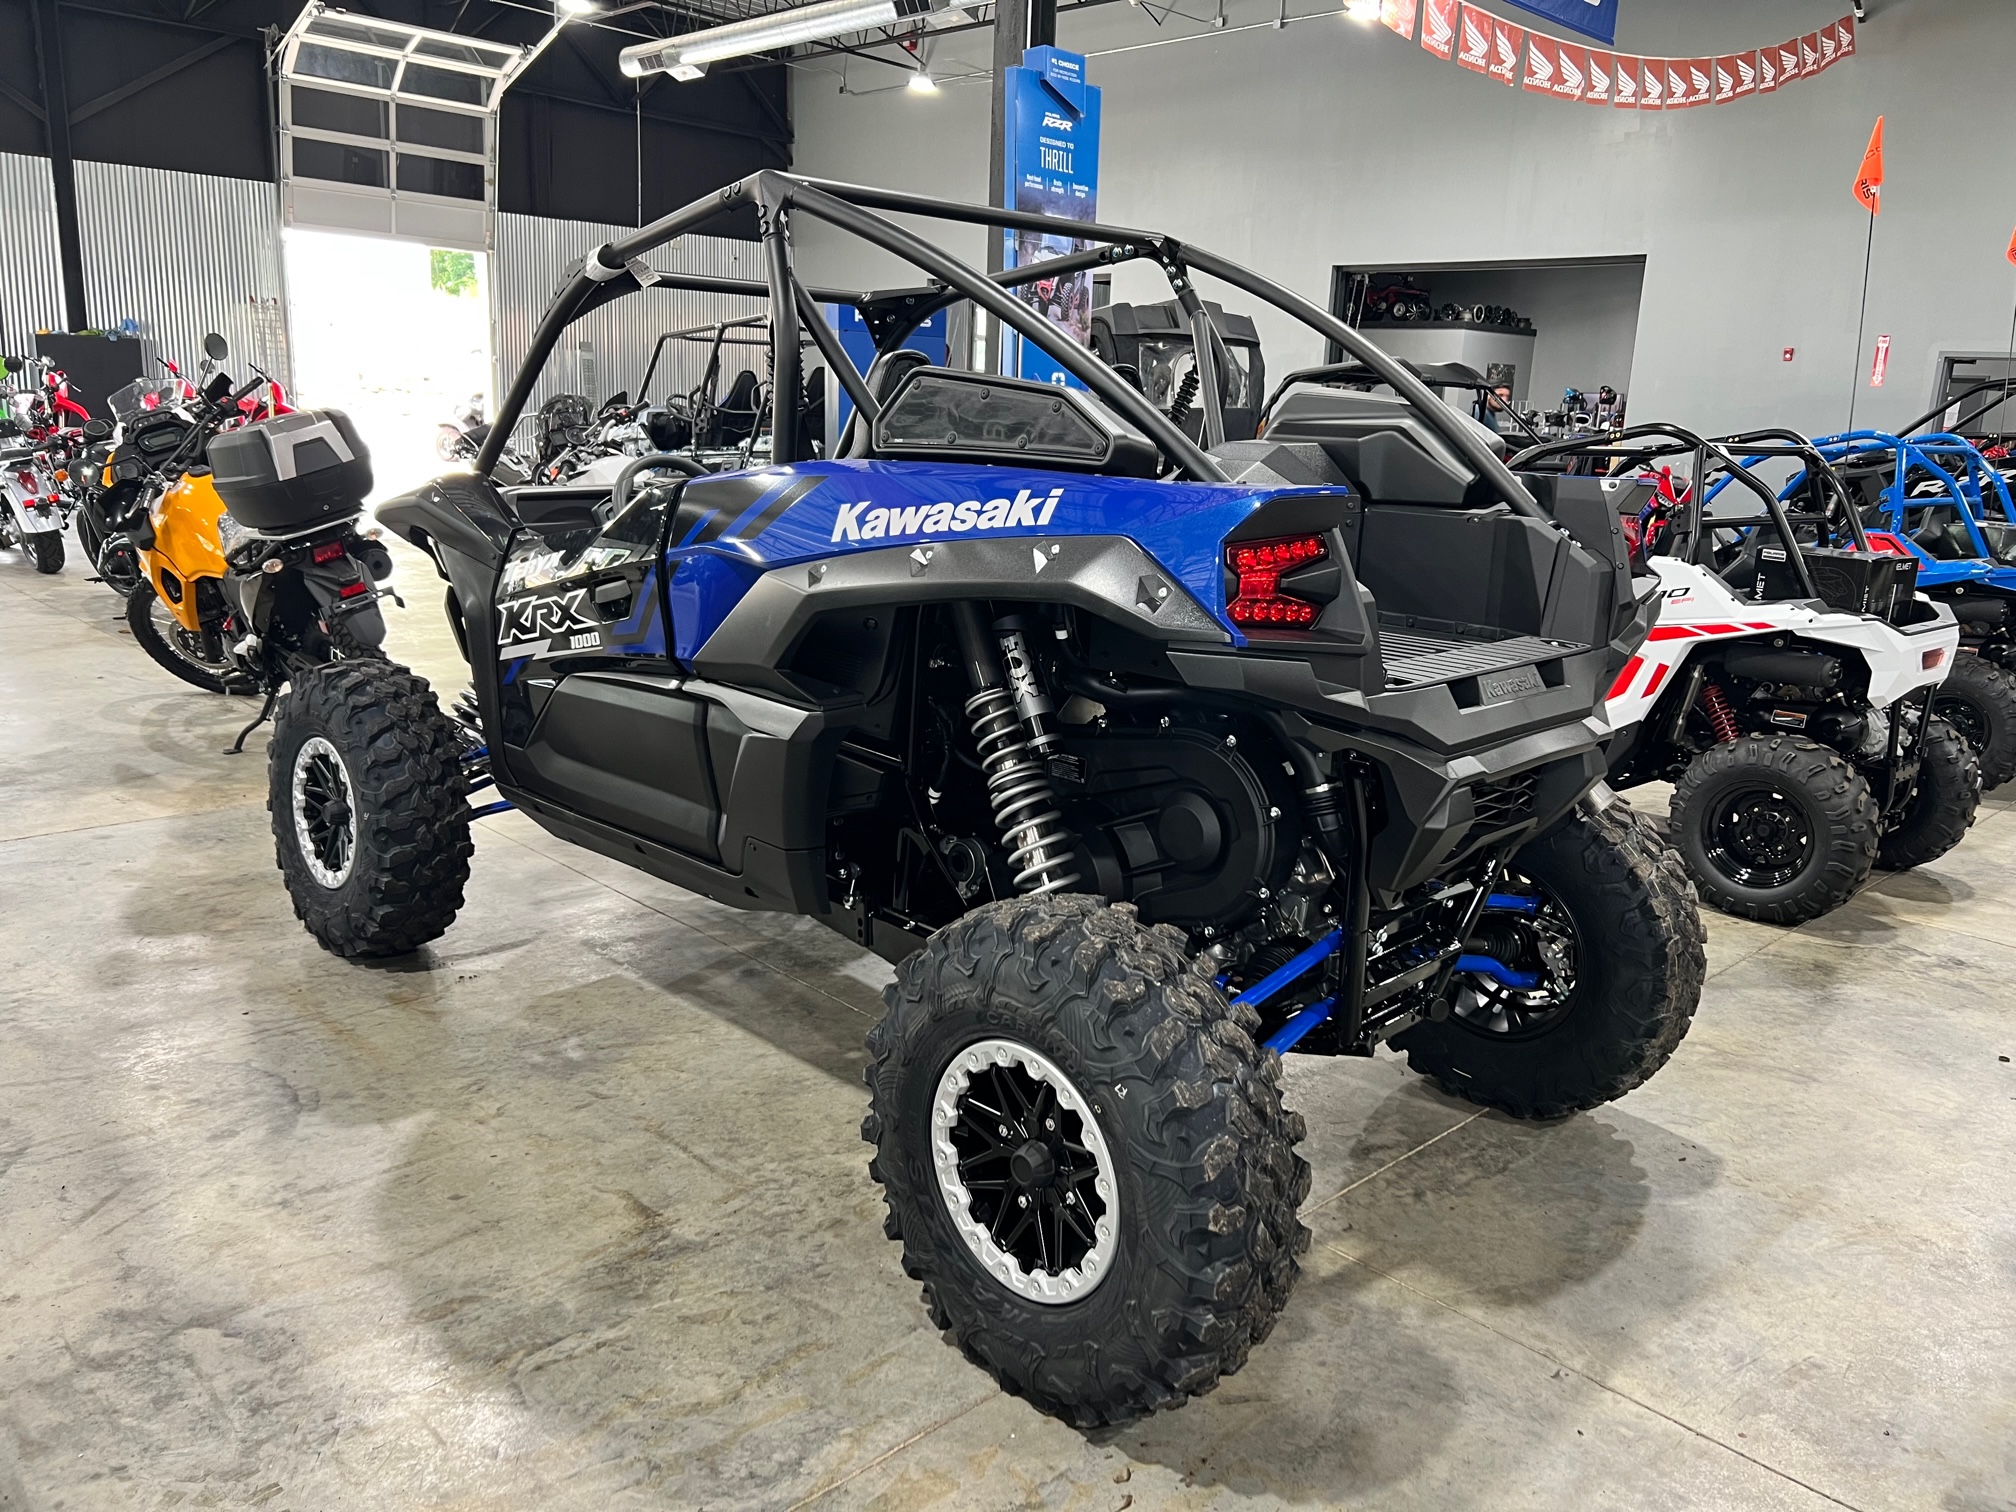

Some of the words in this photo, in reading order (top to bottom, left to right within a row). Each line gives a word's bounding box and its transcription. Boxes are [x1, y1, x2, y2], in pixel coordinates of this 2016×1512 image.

[1058, 59, 1080, 71] CHOICE
[1042, 116, 1073, 132] RZR
[1040, 136, 1067, 148] DESIGNED
[1067, 142, 1075, 150] TO
[1040, 146, 1074, 174] THRILL
[830, 488, 1065, 543] Kawasaki
[503, 550, 566, 585] TERYX
[497, 588, 600, 645] KRX
[569, 632, 601, 649] 1000
[1000, 632, 1040, 705] FOX
[1483, 671, 1541, 699] Kawasaki
